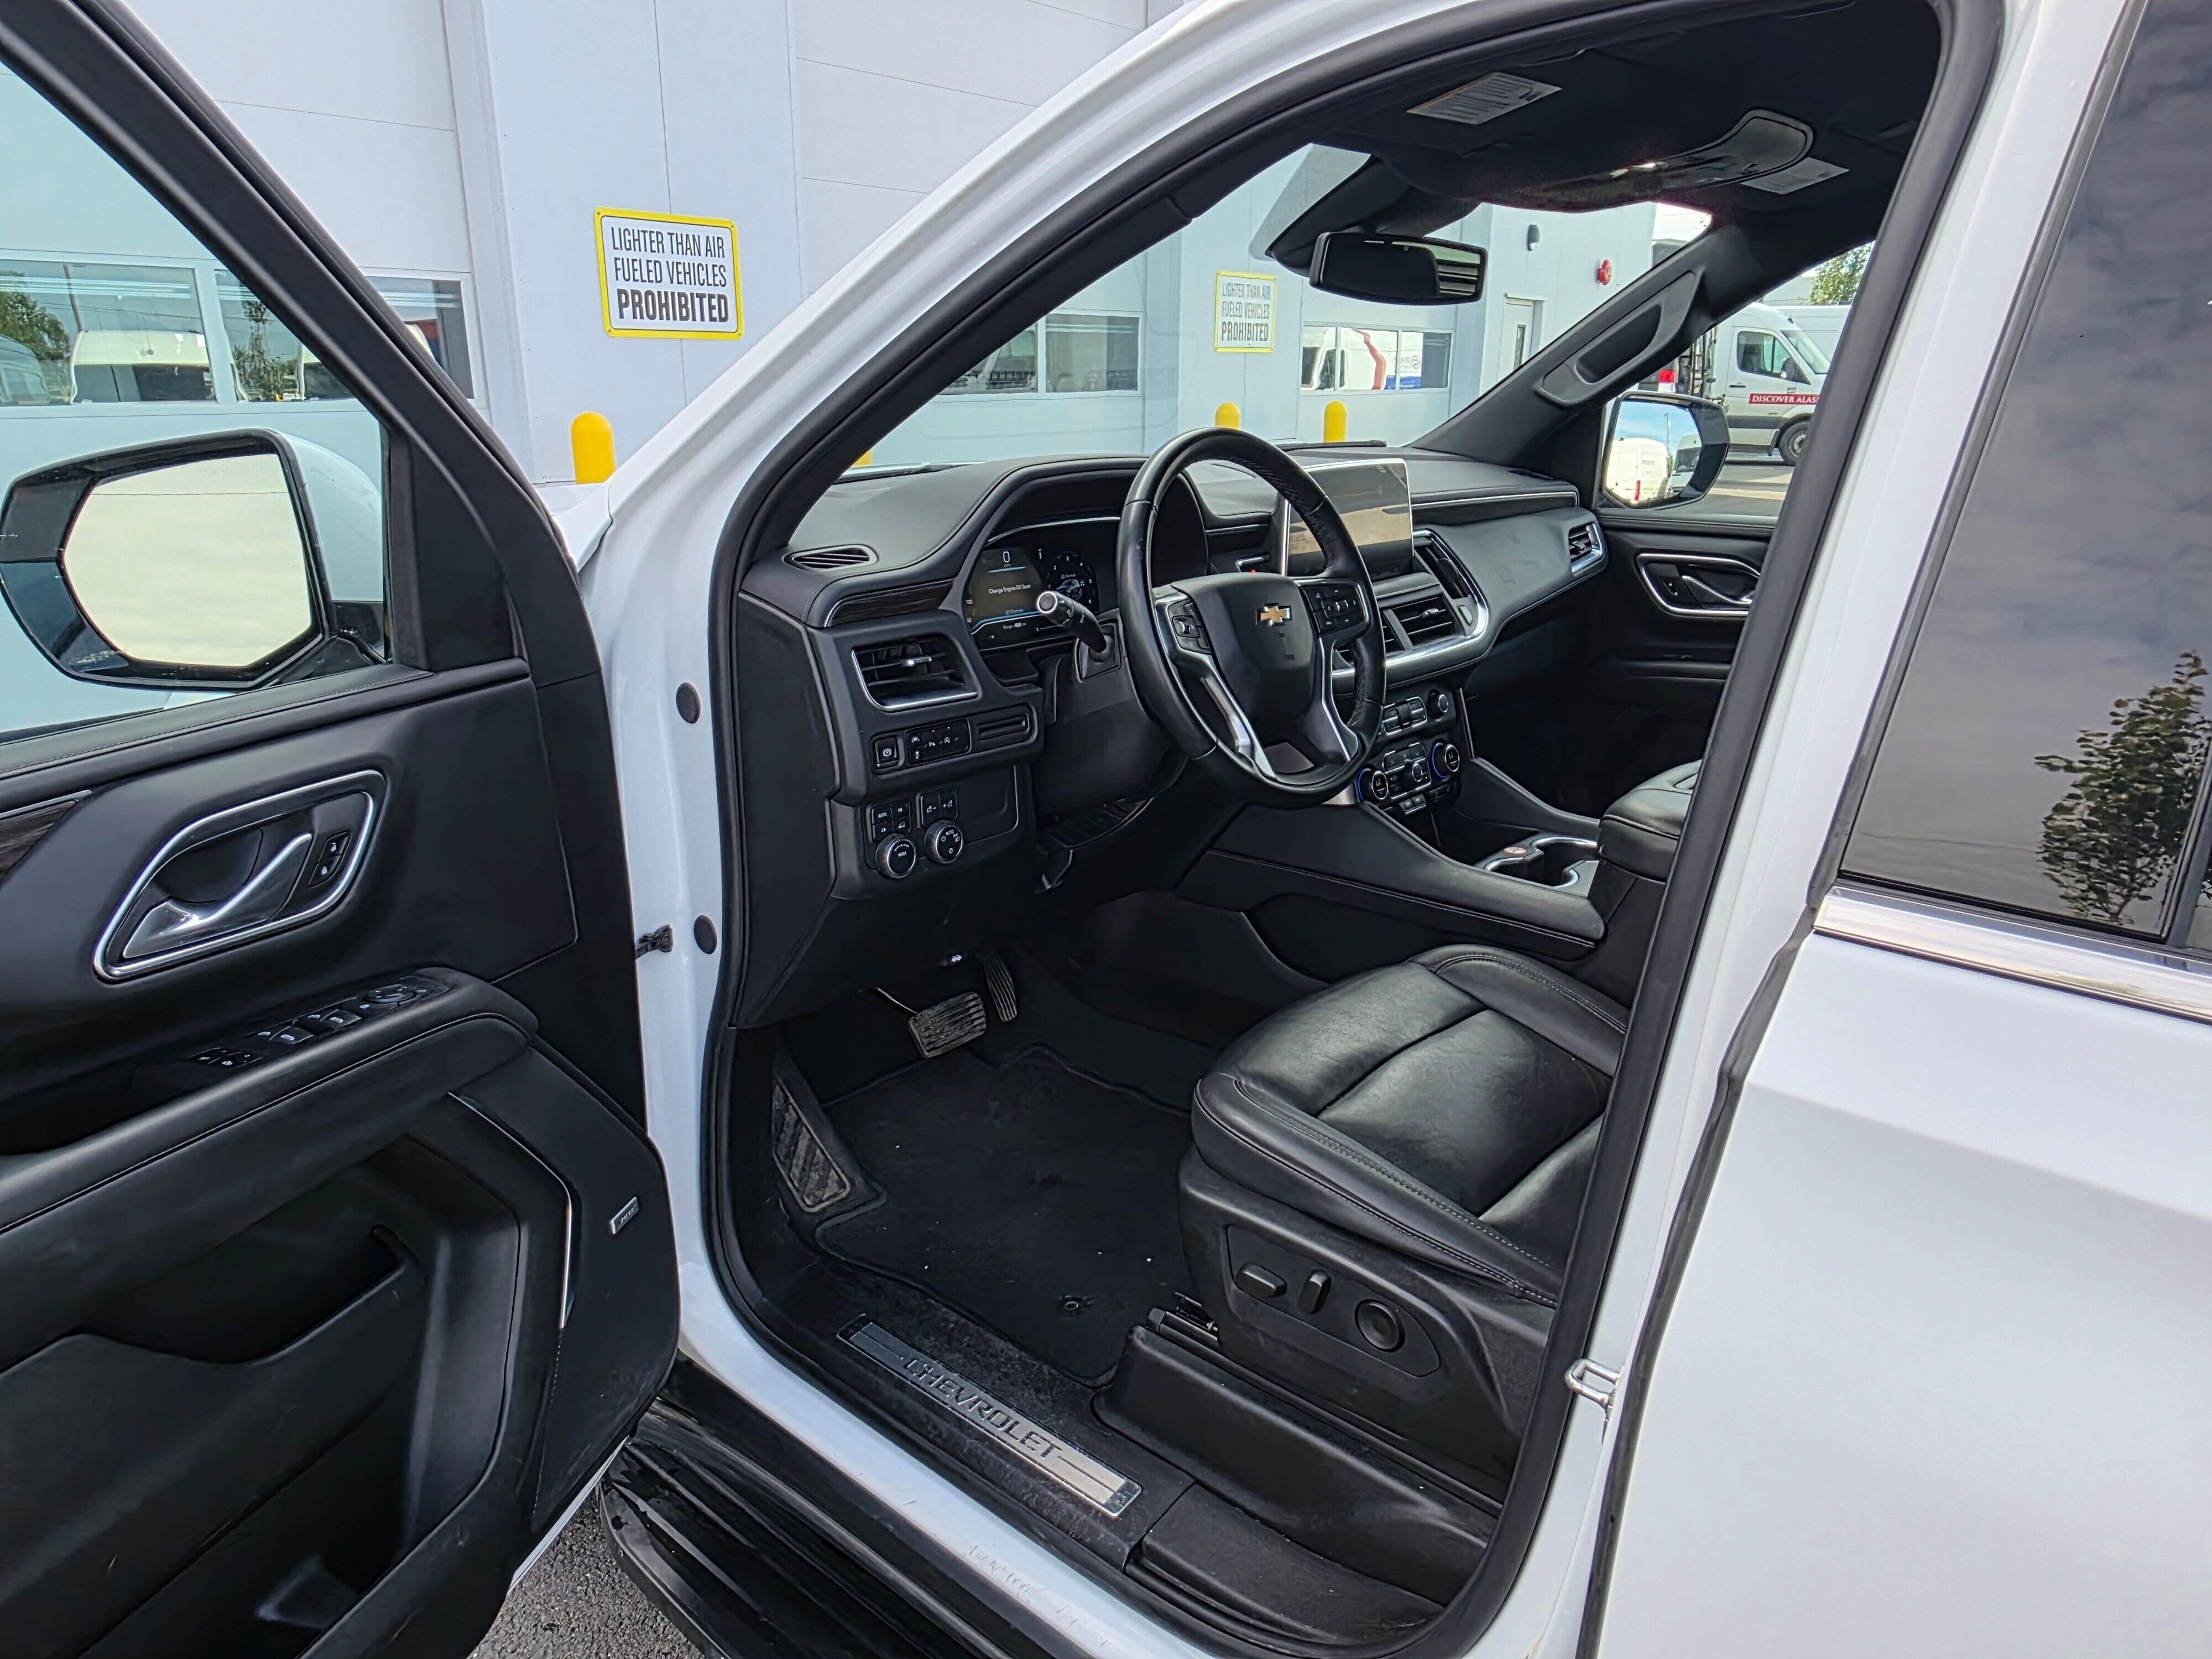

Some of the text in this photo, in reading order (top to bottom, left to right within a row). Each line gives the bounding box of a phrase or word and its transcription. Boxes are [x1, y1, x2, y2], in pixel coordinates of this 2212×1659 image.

[611, 227, 725, 258] LIGHTER THAN AIR
[614, 257, 727, 288] FUELED VEHICLES
[1222, 282, 1271, 300] LIGHTER THAN AIR
[617, 288, 729, 323] PROHIBITED
[1222, 301, 1270, 319] FUELED VEHICLES
[1221, 321, 1269, 342] PROHIBITED
[1752, 395, 1794, 403] DISCOVER
[1003, 551, 1010, 563] 0
[902, 1357, 1062, 1460] CHEVROLET
